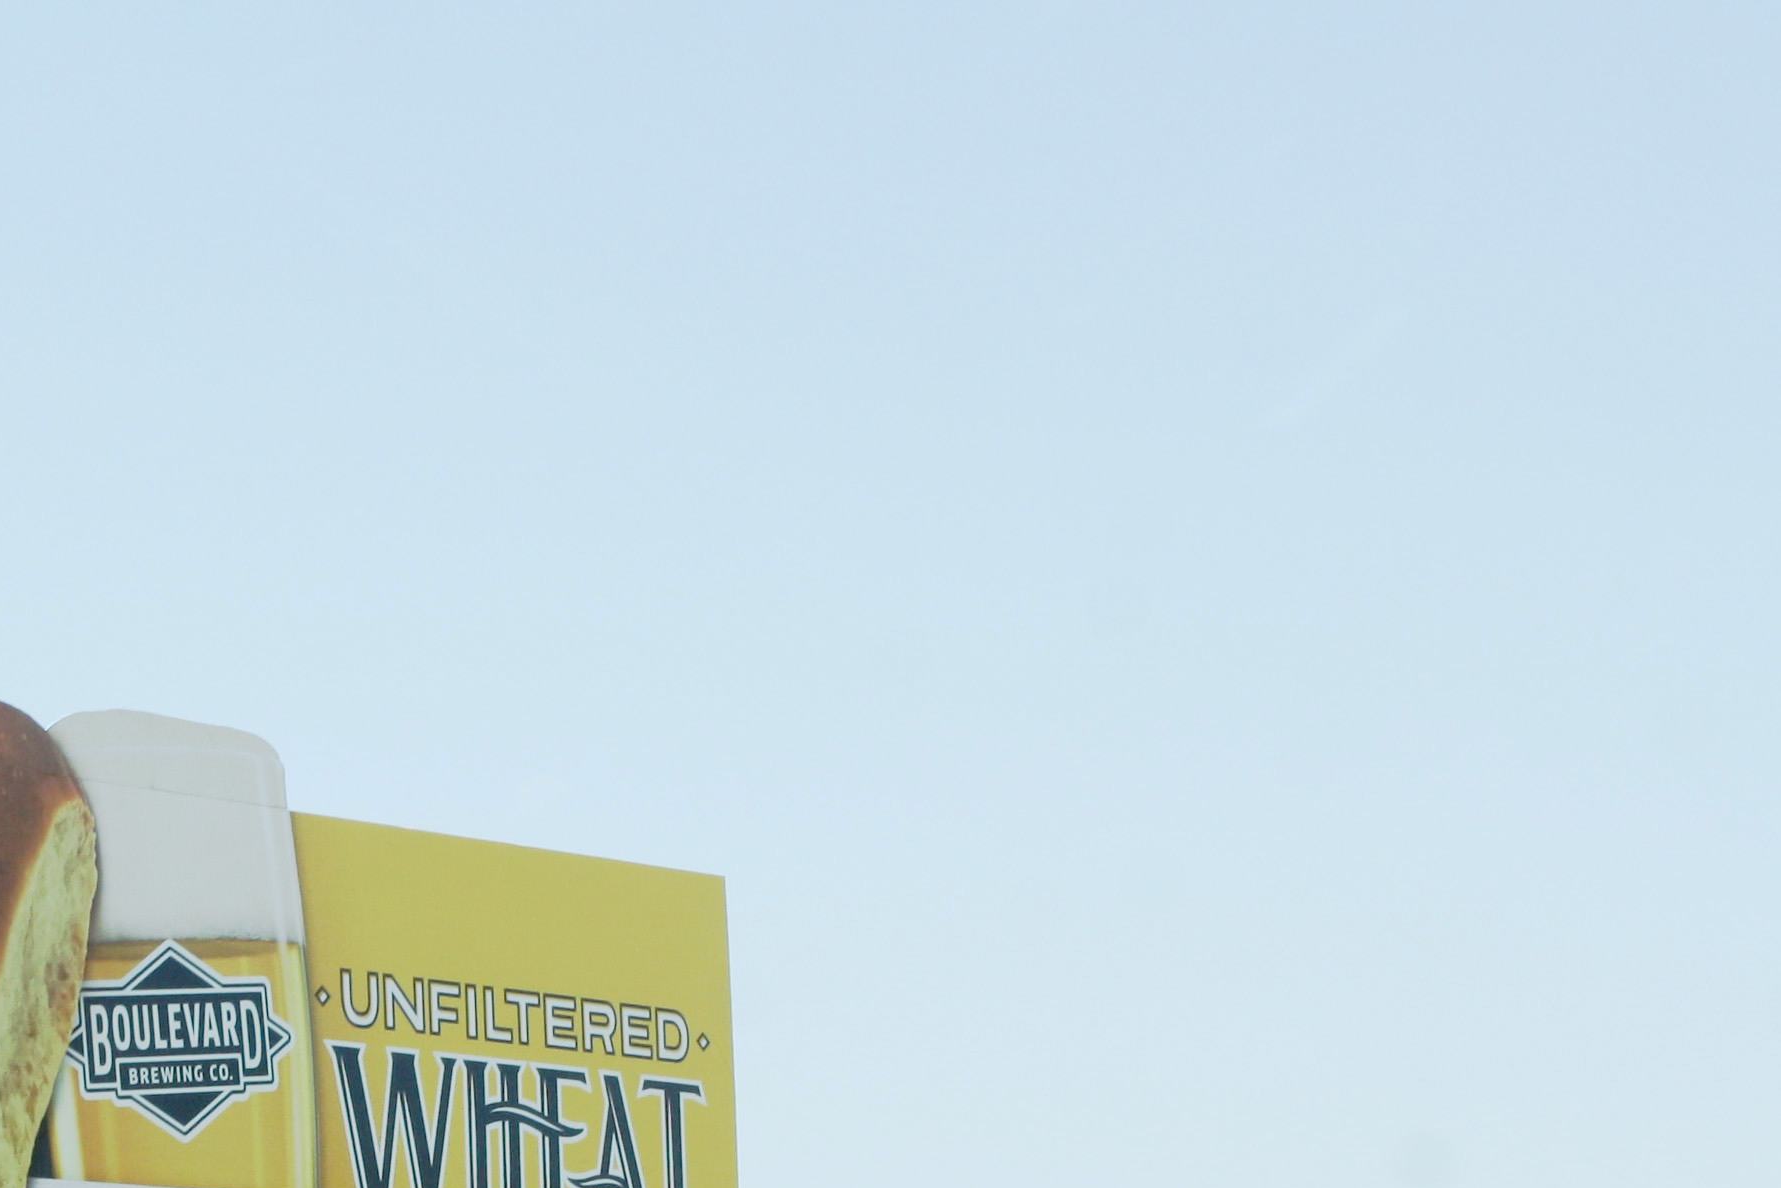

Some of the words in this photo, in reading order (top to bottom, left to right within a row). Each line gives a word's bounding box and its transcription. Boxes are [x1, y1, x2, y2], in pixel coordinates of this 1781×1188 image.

[90, 1000, 263, 1076] BOULEVARD
[340, 968, 689, 1063] UNFILTERED
[129, 1064, 203, 1085] BREWING
[209, 1063, 234, 1081] CO.
